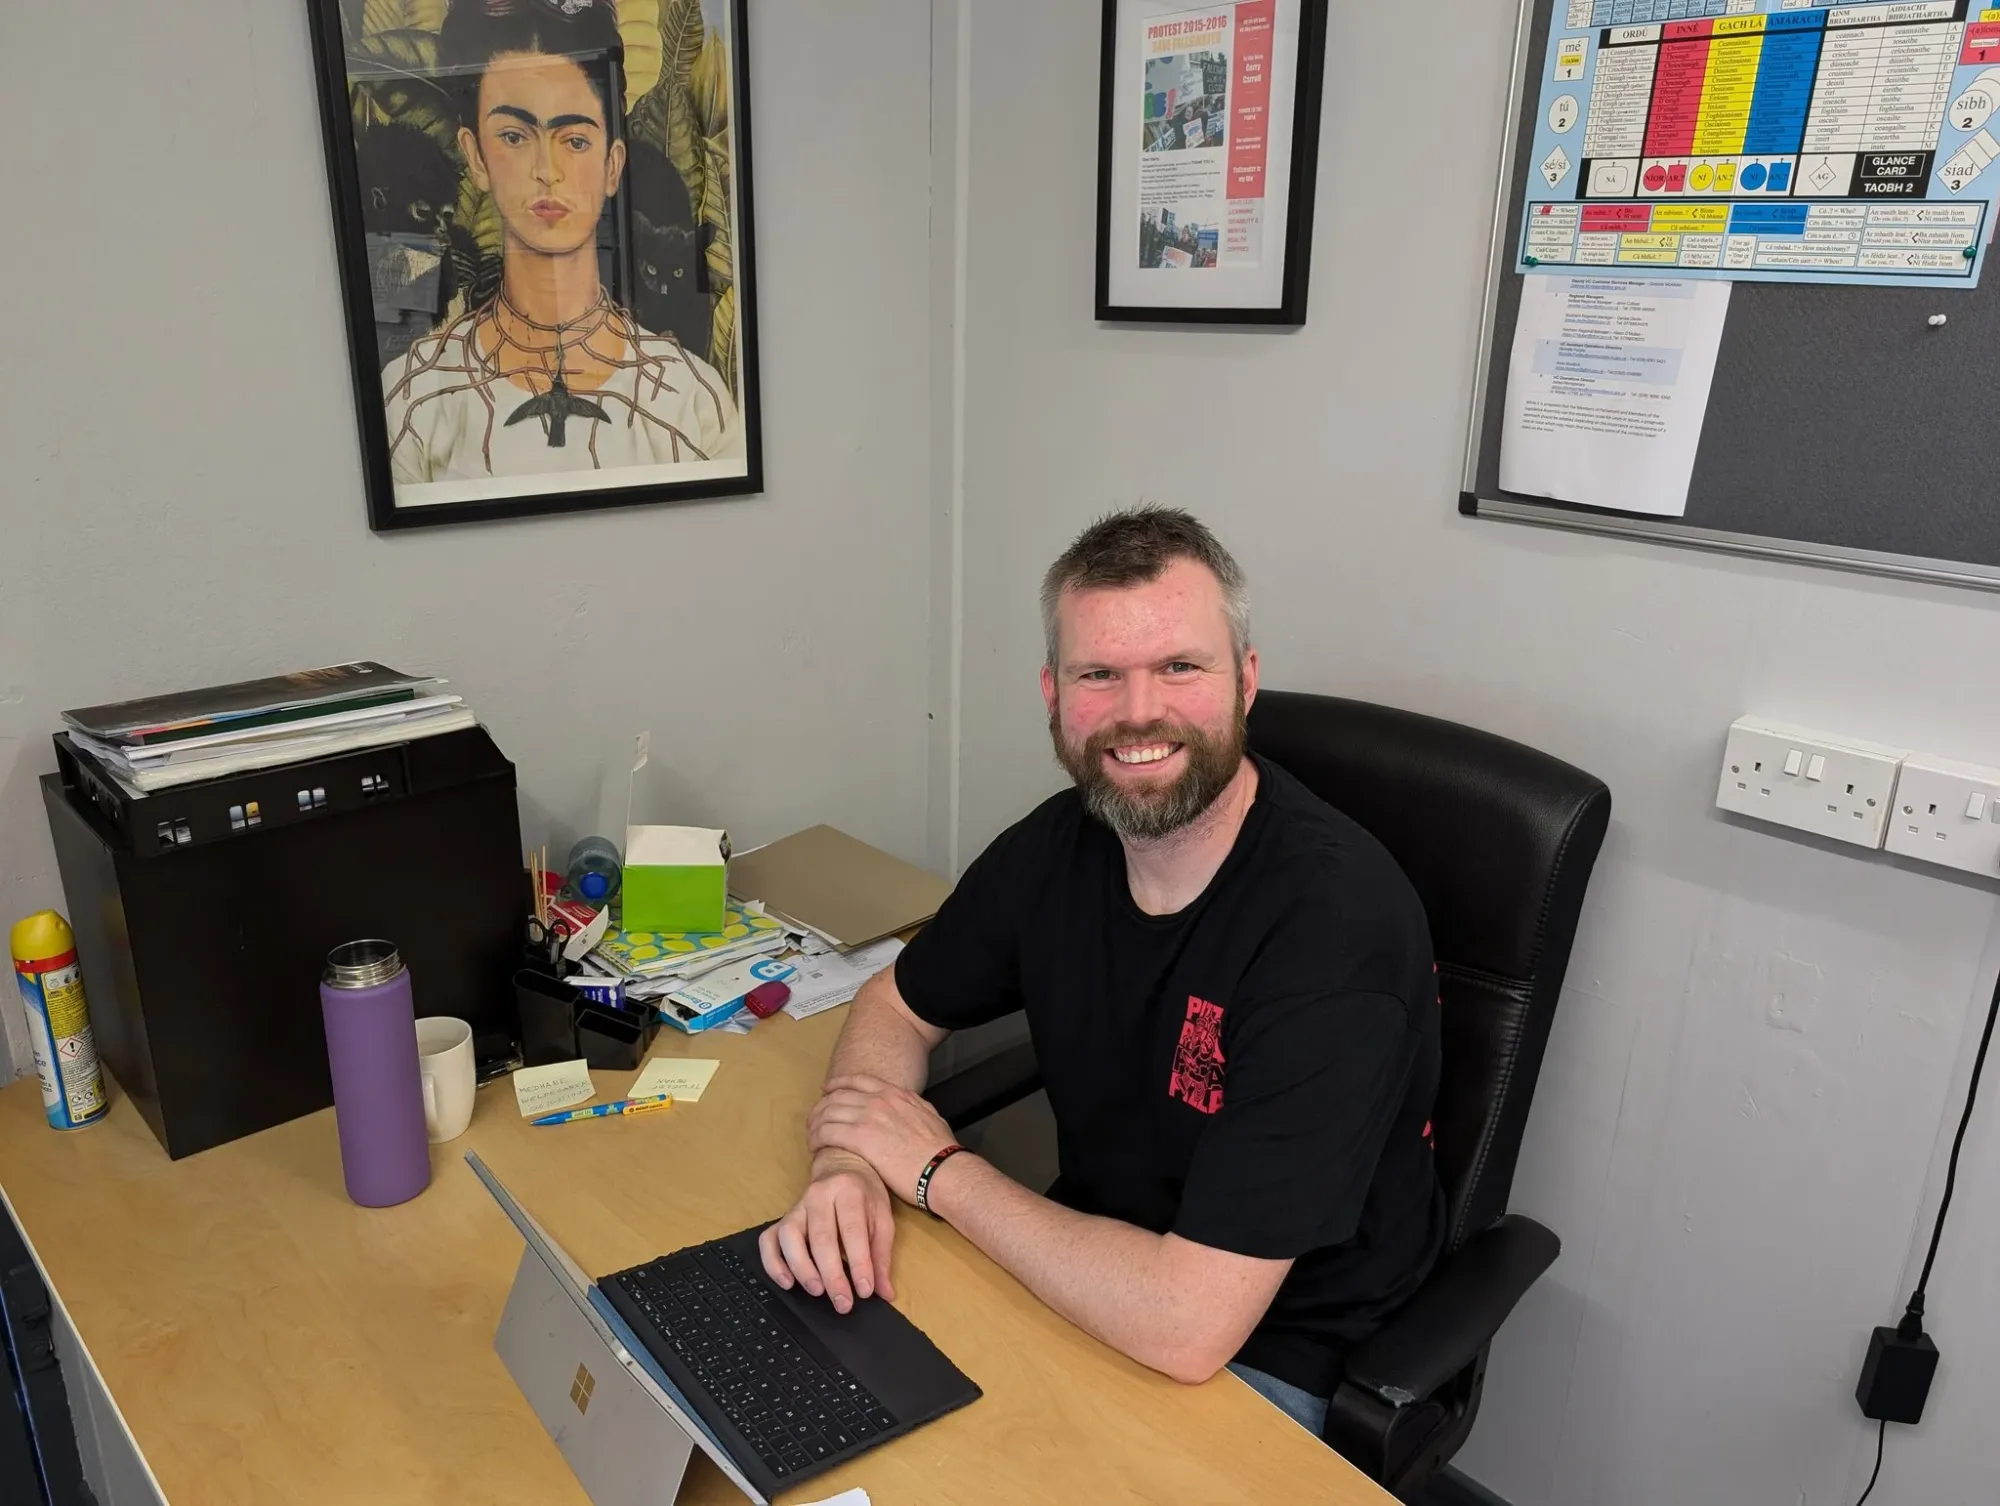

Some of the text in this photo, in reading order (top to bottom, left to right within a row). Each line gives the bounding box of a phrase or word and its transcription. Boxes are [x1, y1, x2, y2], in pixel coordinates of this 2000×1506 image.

[1890, 4, 1927, 12] AIDIACHT
[1719, 18, 1763, 30] GACH LÁ
[1768, 14, 1823, 27] AMÁRACH
[1829, 15, 1881, 24] BRIATHARTHA
[1148, 22, 1182, 39] PROTEST
[1184, 16, 1227, 33] 2015-2016
[1676, 22, 1700, 34] INNÉ
[1622, 28, 1648, 38] ORDÚ
[1565, 40, 1581, 52] mé
[1979, 50, 1985, 61] 1
[1566, 69, 1572, 78] 1
[1560, 101, 1569, 112] tú
[1956, 97, 1986, 110] sibh
[1558, 118, 1566, 127] 2
[1962, 118, 1972, 128] 2
[1544, 160, 1566, 170] sé/sí
[1872, 157, 1916, 166] GLANCE
[1877, 167, 1907, 176] CARD
[1944, 164, 1974, 176] siad
[1550, 173, 1557, 182] 3
[1606, 174, 1616, 183] NÁ
[1646, 173, 1664, 182] NÍOR
[1816, 172, 1829, 180] AG
[1864, 183, 1914, 193] TAOBH 2
[1951, 180, 1960, 190] 3
[918, 1178, 927, 1210] FREE
